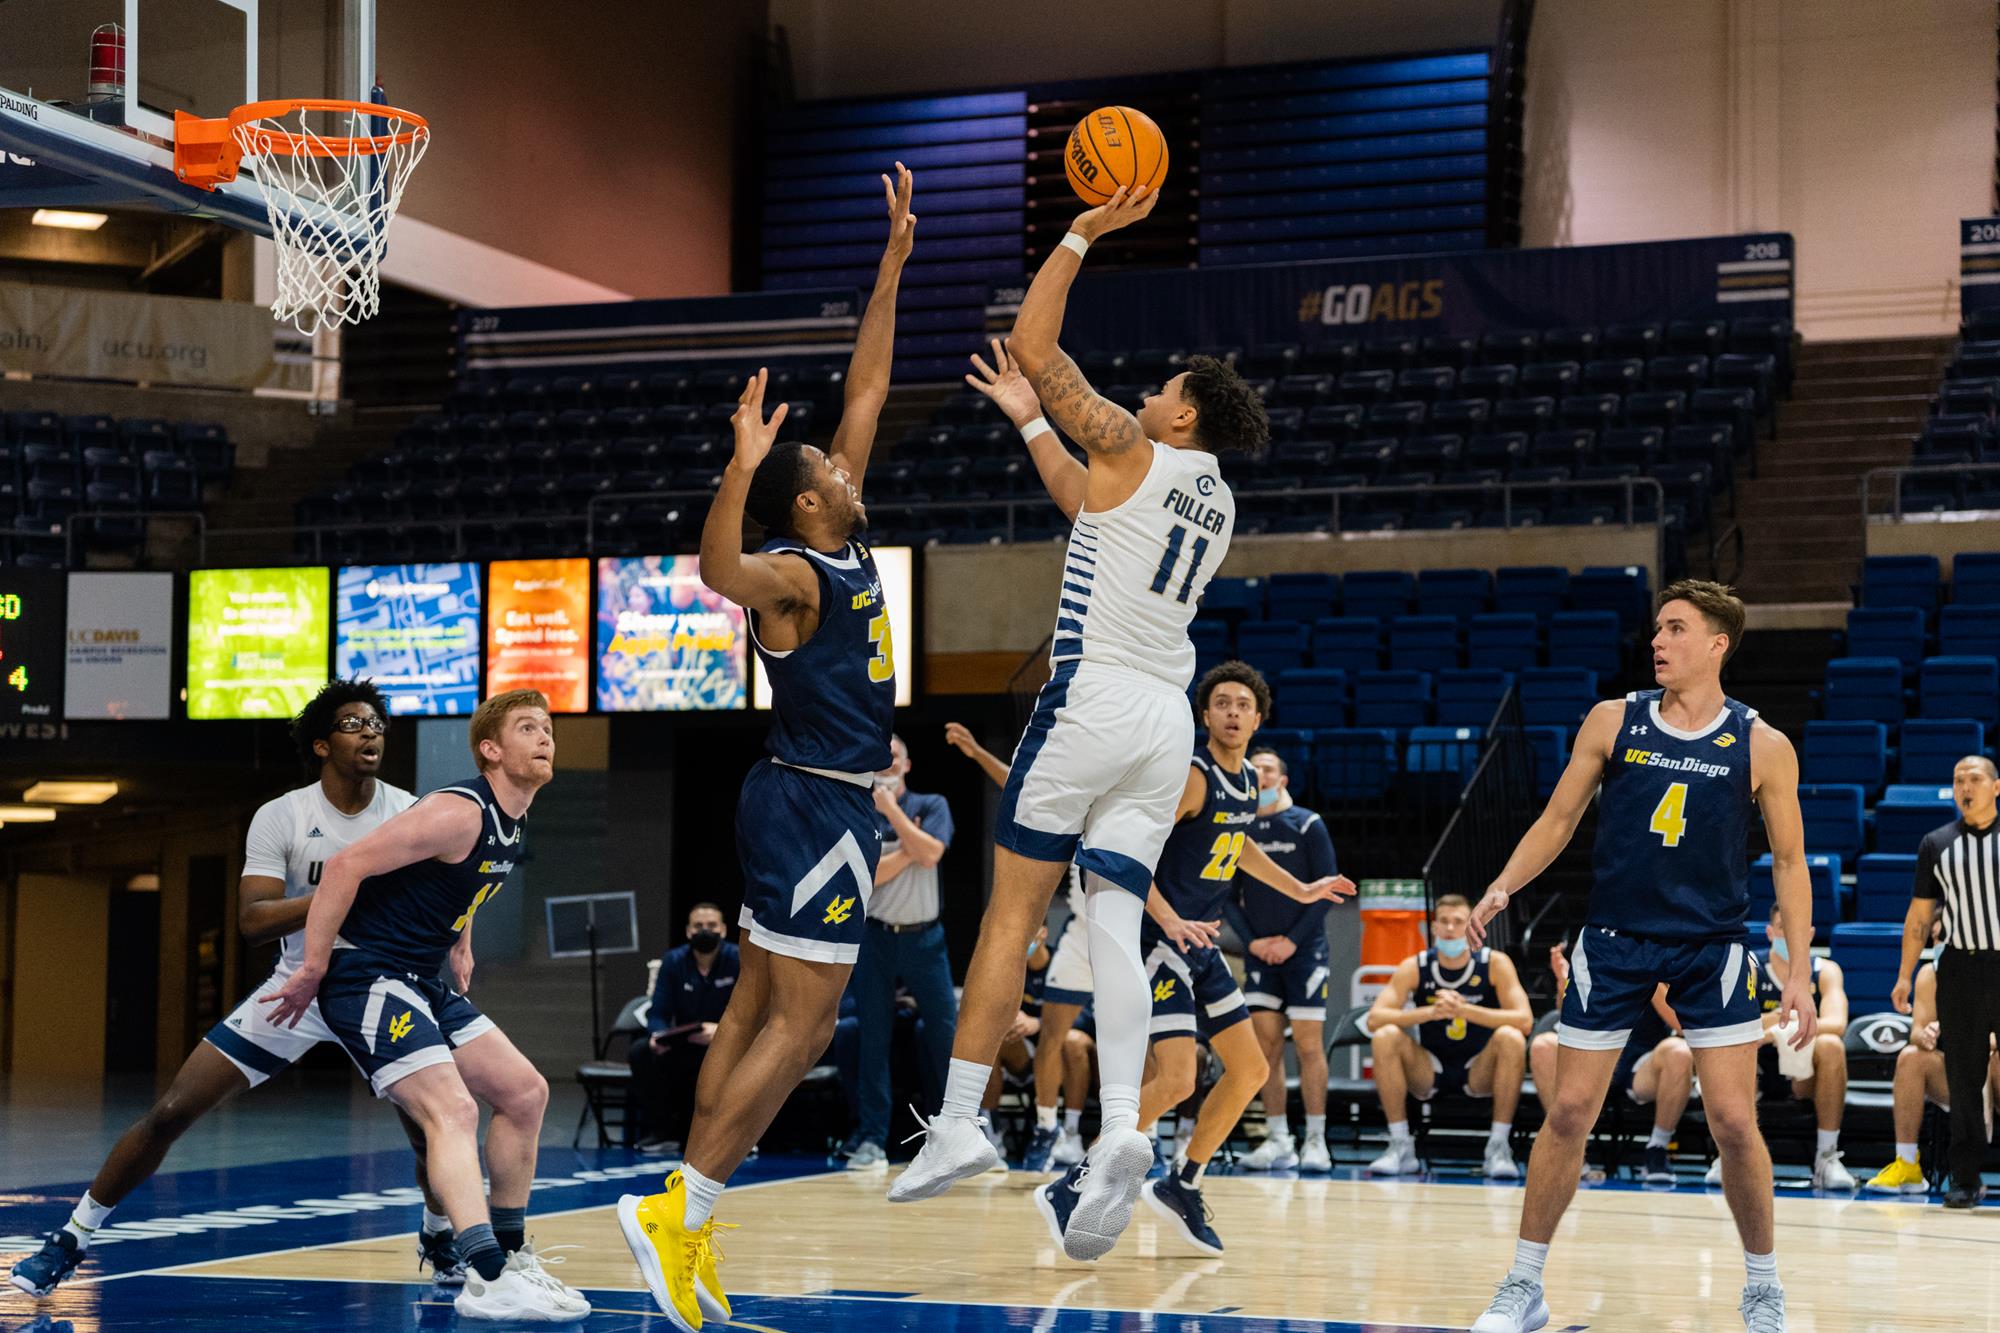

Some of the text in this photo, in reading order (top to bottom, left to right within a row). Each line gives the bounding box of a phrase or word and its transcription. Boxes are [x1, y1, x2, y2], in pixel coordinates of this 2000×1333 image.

[1745, 242, 1781, 260] 208
[1298, 279, 1444, 325] #GOAGS
[1162, 487, 1226, 536] FULLER
[1149, 523, 1210, 605] 11
[93, 628, 140, 643] DAVIS
[8, 665, 28, 691] 4
[1649, 782, 1689, 847] 4
